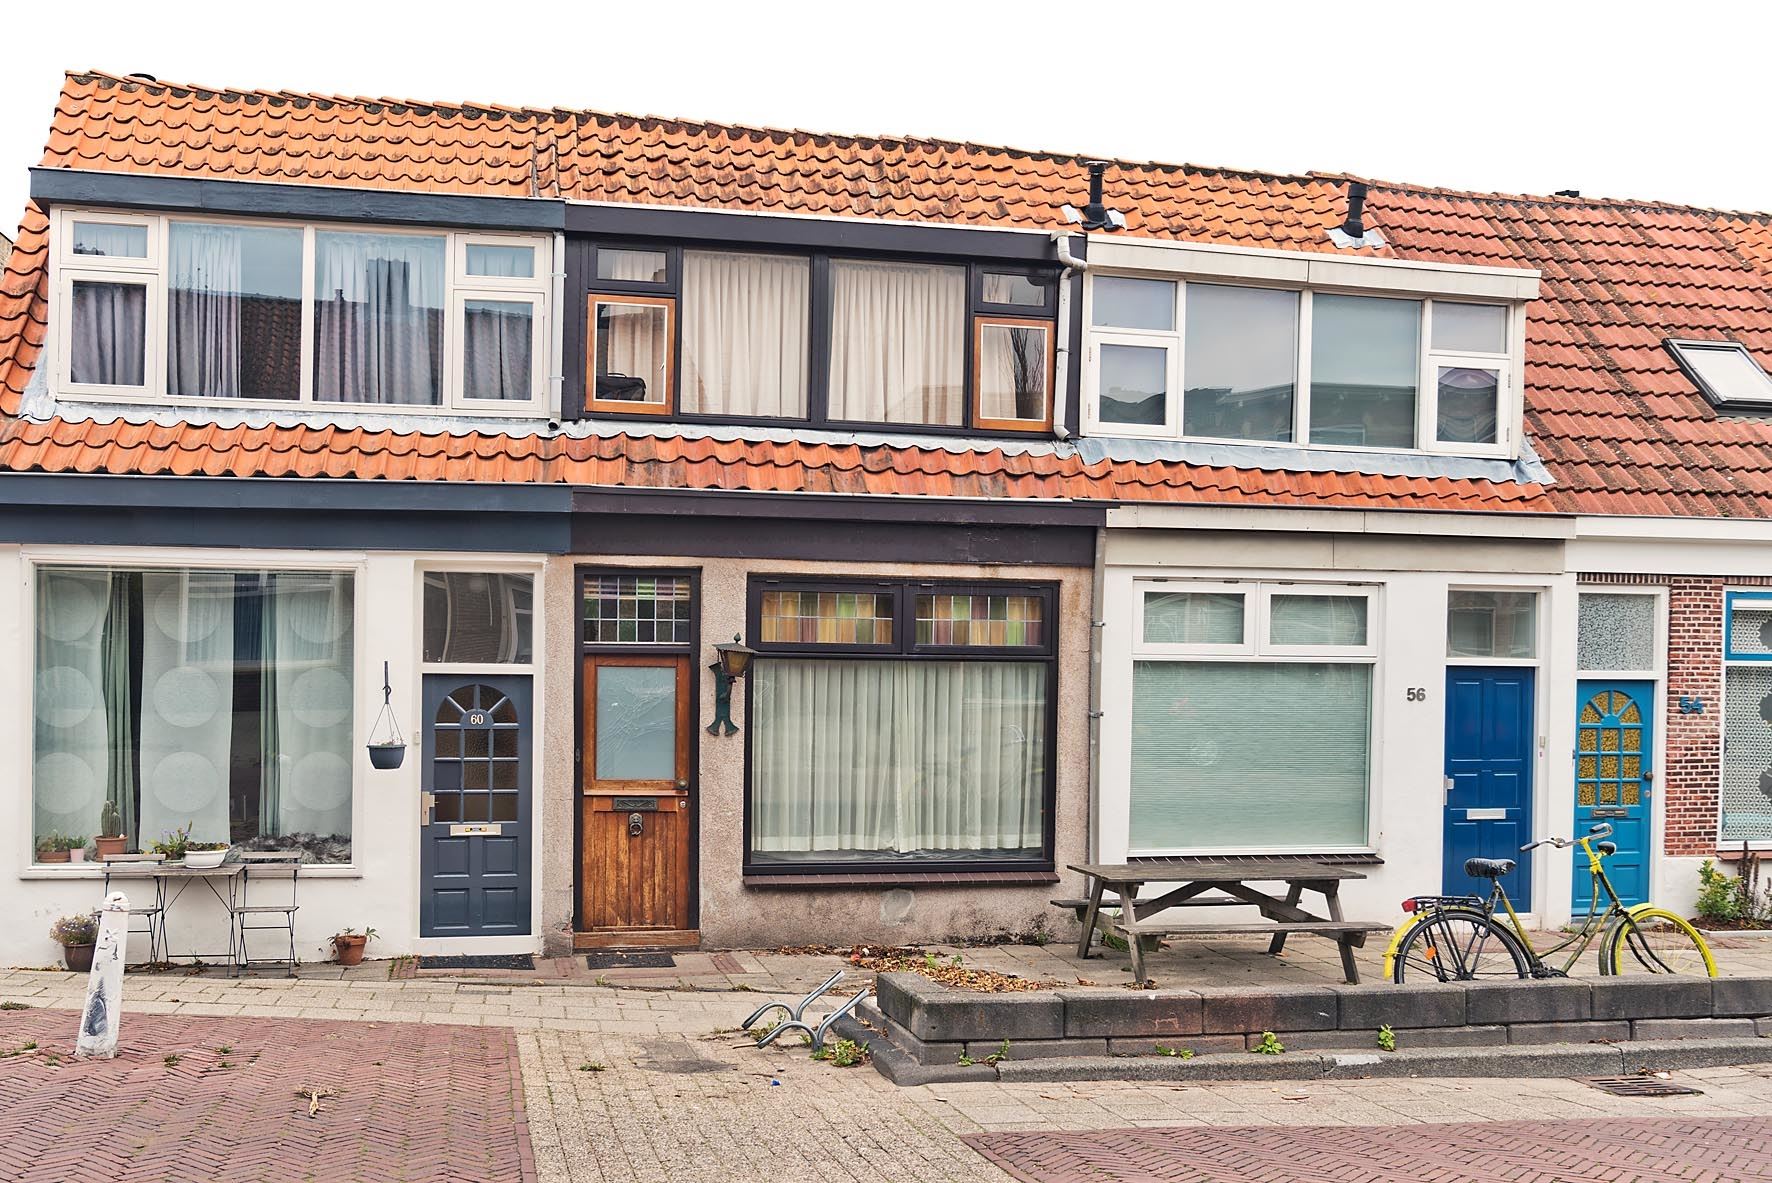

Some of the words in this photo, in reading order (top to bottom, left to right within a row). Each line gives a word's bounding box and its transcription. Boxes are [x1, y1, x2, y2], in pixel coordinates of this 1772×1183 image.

[1407, 687, 1426, 701] 56
[1679, 696, 1704, 714] 54
[470, 713, 484, 725] 60
